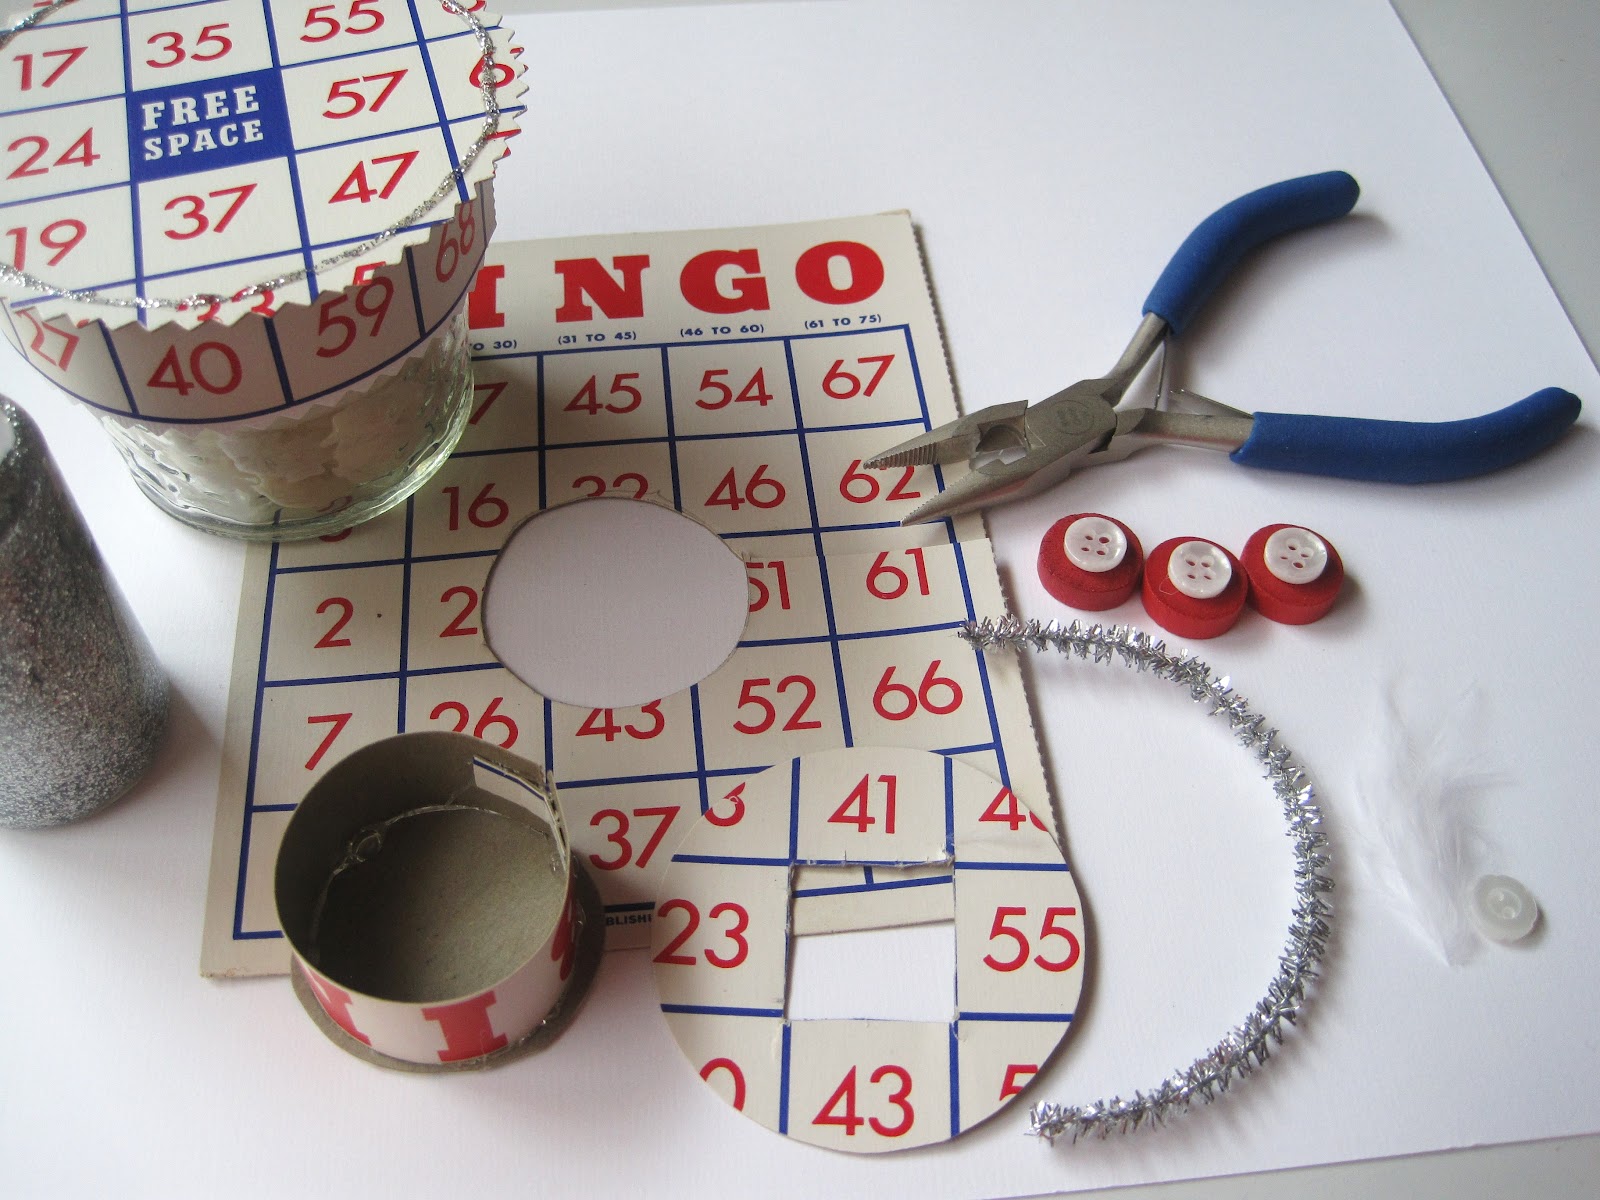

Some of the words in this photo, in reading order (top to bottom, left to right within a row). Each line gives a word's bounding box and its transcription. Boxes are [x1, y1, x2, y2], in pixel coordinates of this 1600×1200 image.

[147, 23, 232, 68] 35
[301, 0, 384, 42] 55
[13, 46, 88, 91] 17
[323, 69, 408, 119] 57
[142, 85, 260, 131] FREE
[7, 127, 100, 180] 24
[144, 119, 264, 161] SPACE
[329, 150, 419, 204] 47
[165, 184, 256, 240] 37
[5, 219, 88, 271] 19
[436, 201, 476, 283] 68
[316, 276, 394, 358] 59
[586, 333, 605, 342] TO
[712, 326, 731, 335] TO
[832, 317, 851, 327] TO
[147, 341, 243, 396] 40
[563, 372, 642, 415] 45
[696, 367, 773, 411] 54
[822, 354, 895, 400] 67
[441, 483, 510, 531] 16
[704, 464, 786, 511] 46
[839, 459, 921, 504] 62
[866, 547, 930, 600] 61
[315, 598, 354, 648] 2
[734, 675, 822, 735] 52
[873, 660, 963, 721] 66
[305, 713, 352, 771] 7
[430, 697, 519, 750] 26
[828, 774, 897, 834] 41
[979, 787, 1049, 832] 4
[589, 806, 681, 870] 37
[653, 898, 749, 969] 23
[983, 906, 1080, 972] 55
[811, 1064, 915, 1138] 43
